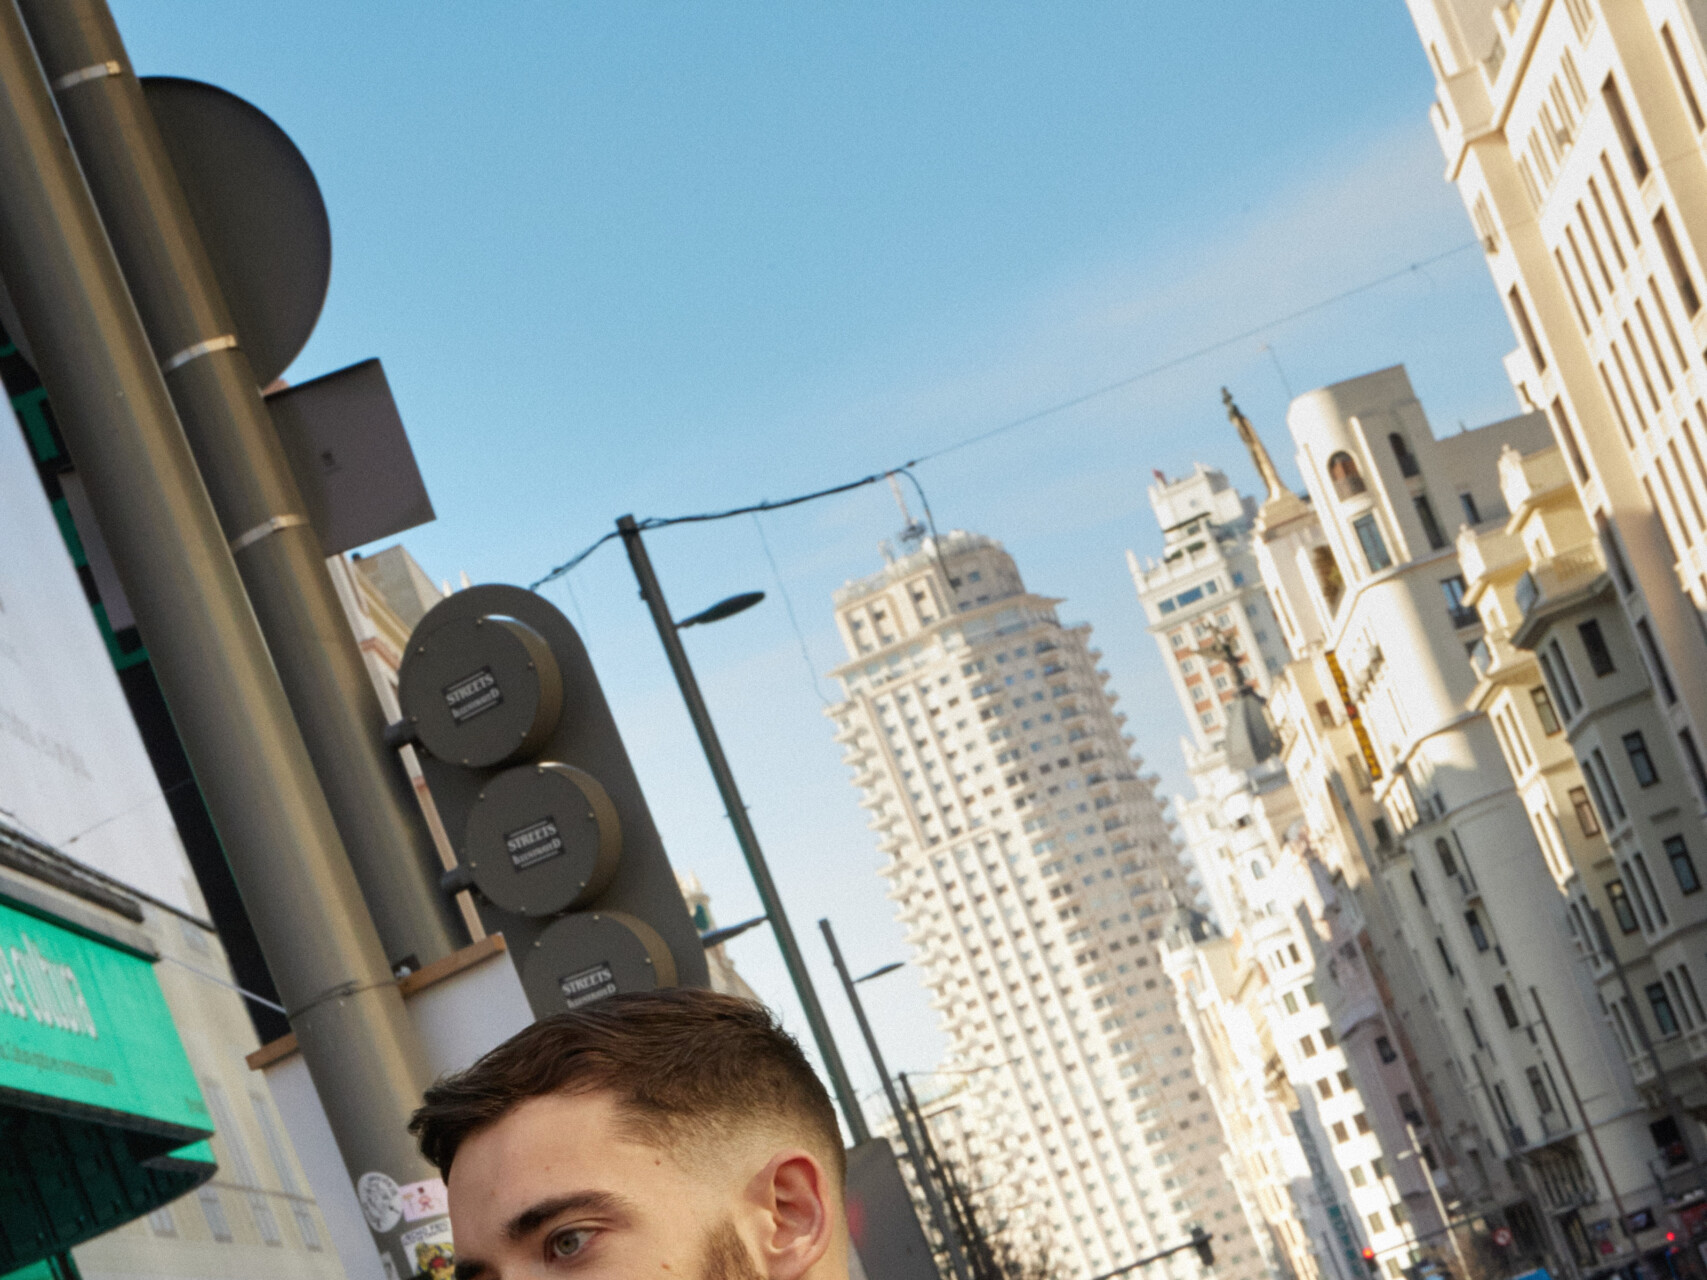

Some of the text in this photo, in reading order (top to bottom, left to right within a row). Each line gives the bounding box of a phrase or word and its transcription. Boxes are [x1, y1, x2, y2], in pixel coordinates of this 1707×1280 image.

[446, 674, 494, 705] STREETS
[507, 823, 557, 852] STREETS
[561, 968, 612, 996] STREETS
